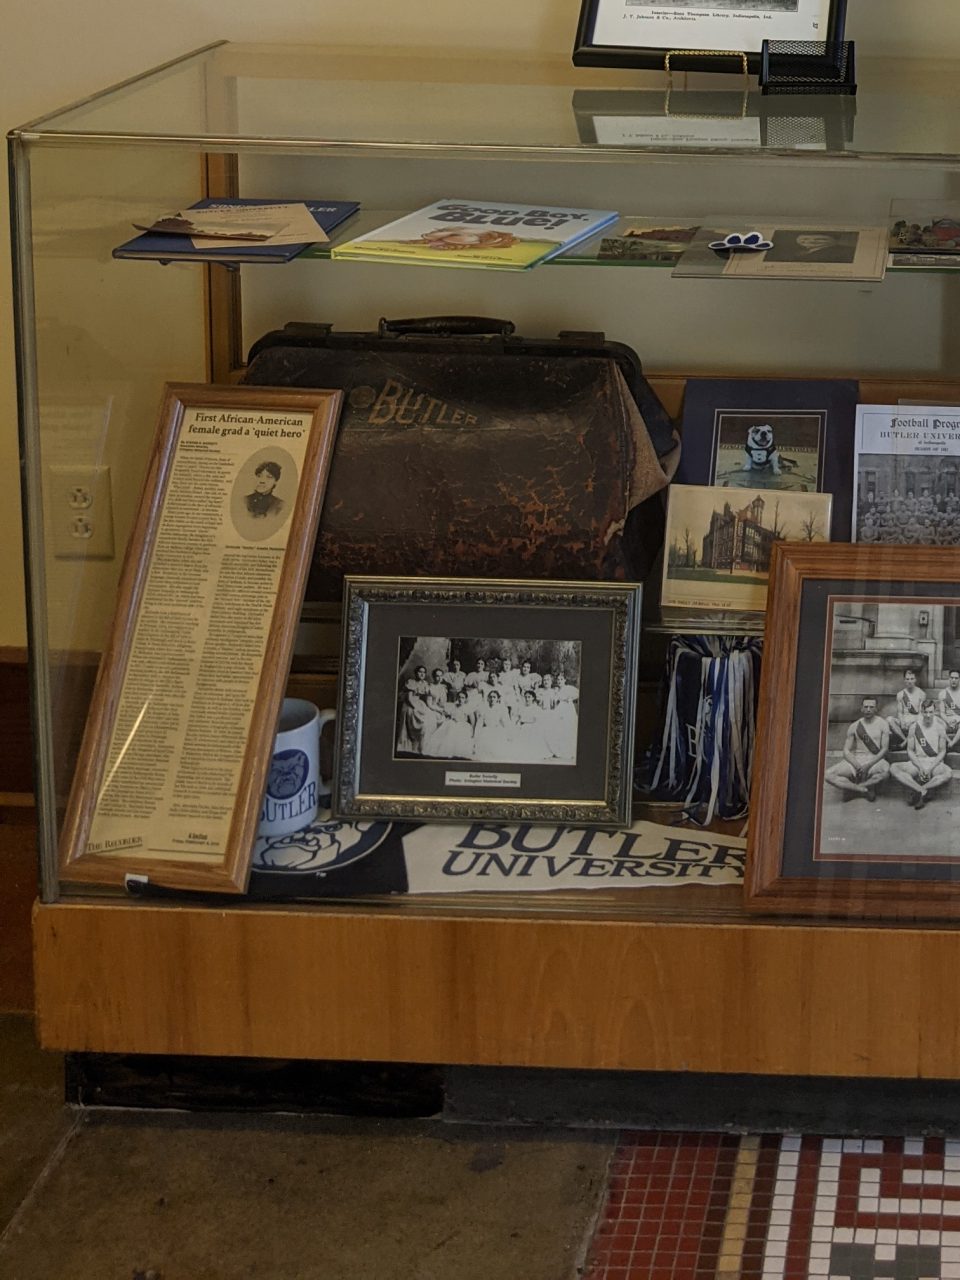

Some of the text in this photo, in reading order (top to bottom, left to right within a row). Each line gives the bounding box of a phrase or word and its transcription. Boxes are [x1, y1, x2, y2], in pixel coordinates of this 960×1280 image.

[368, 379, 478, 424] BUTLER
[194, 412, 303, 426] First African-American
[890, 418, 929, 428] Football
[188, 424, 220, 434] female
[221, 426, 243, 437] grad
[455, 824, 747, 865] BUTLER
